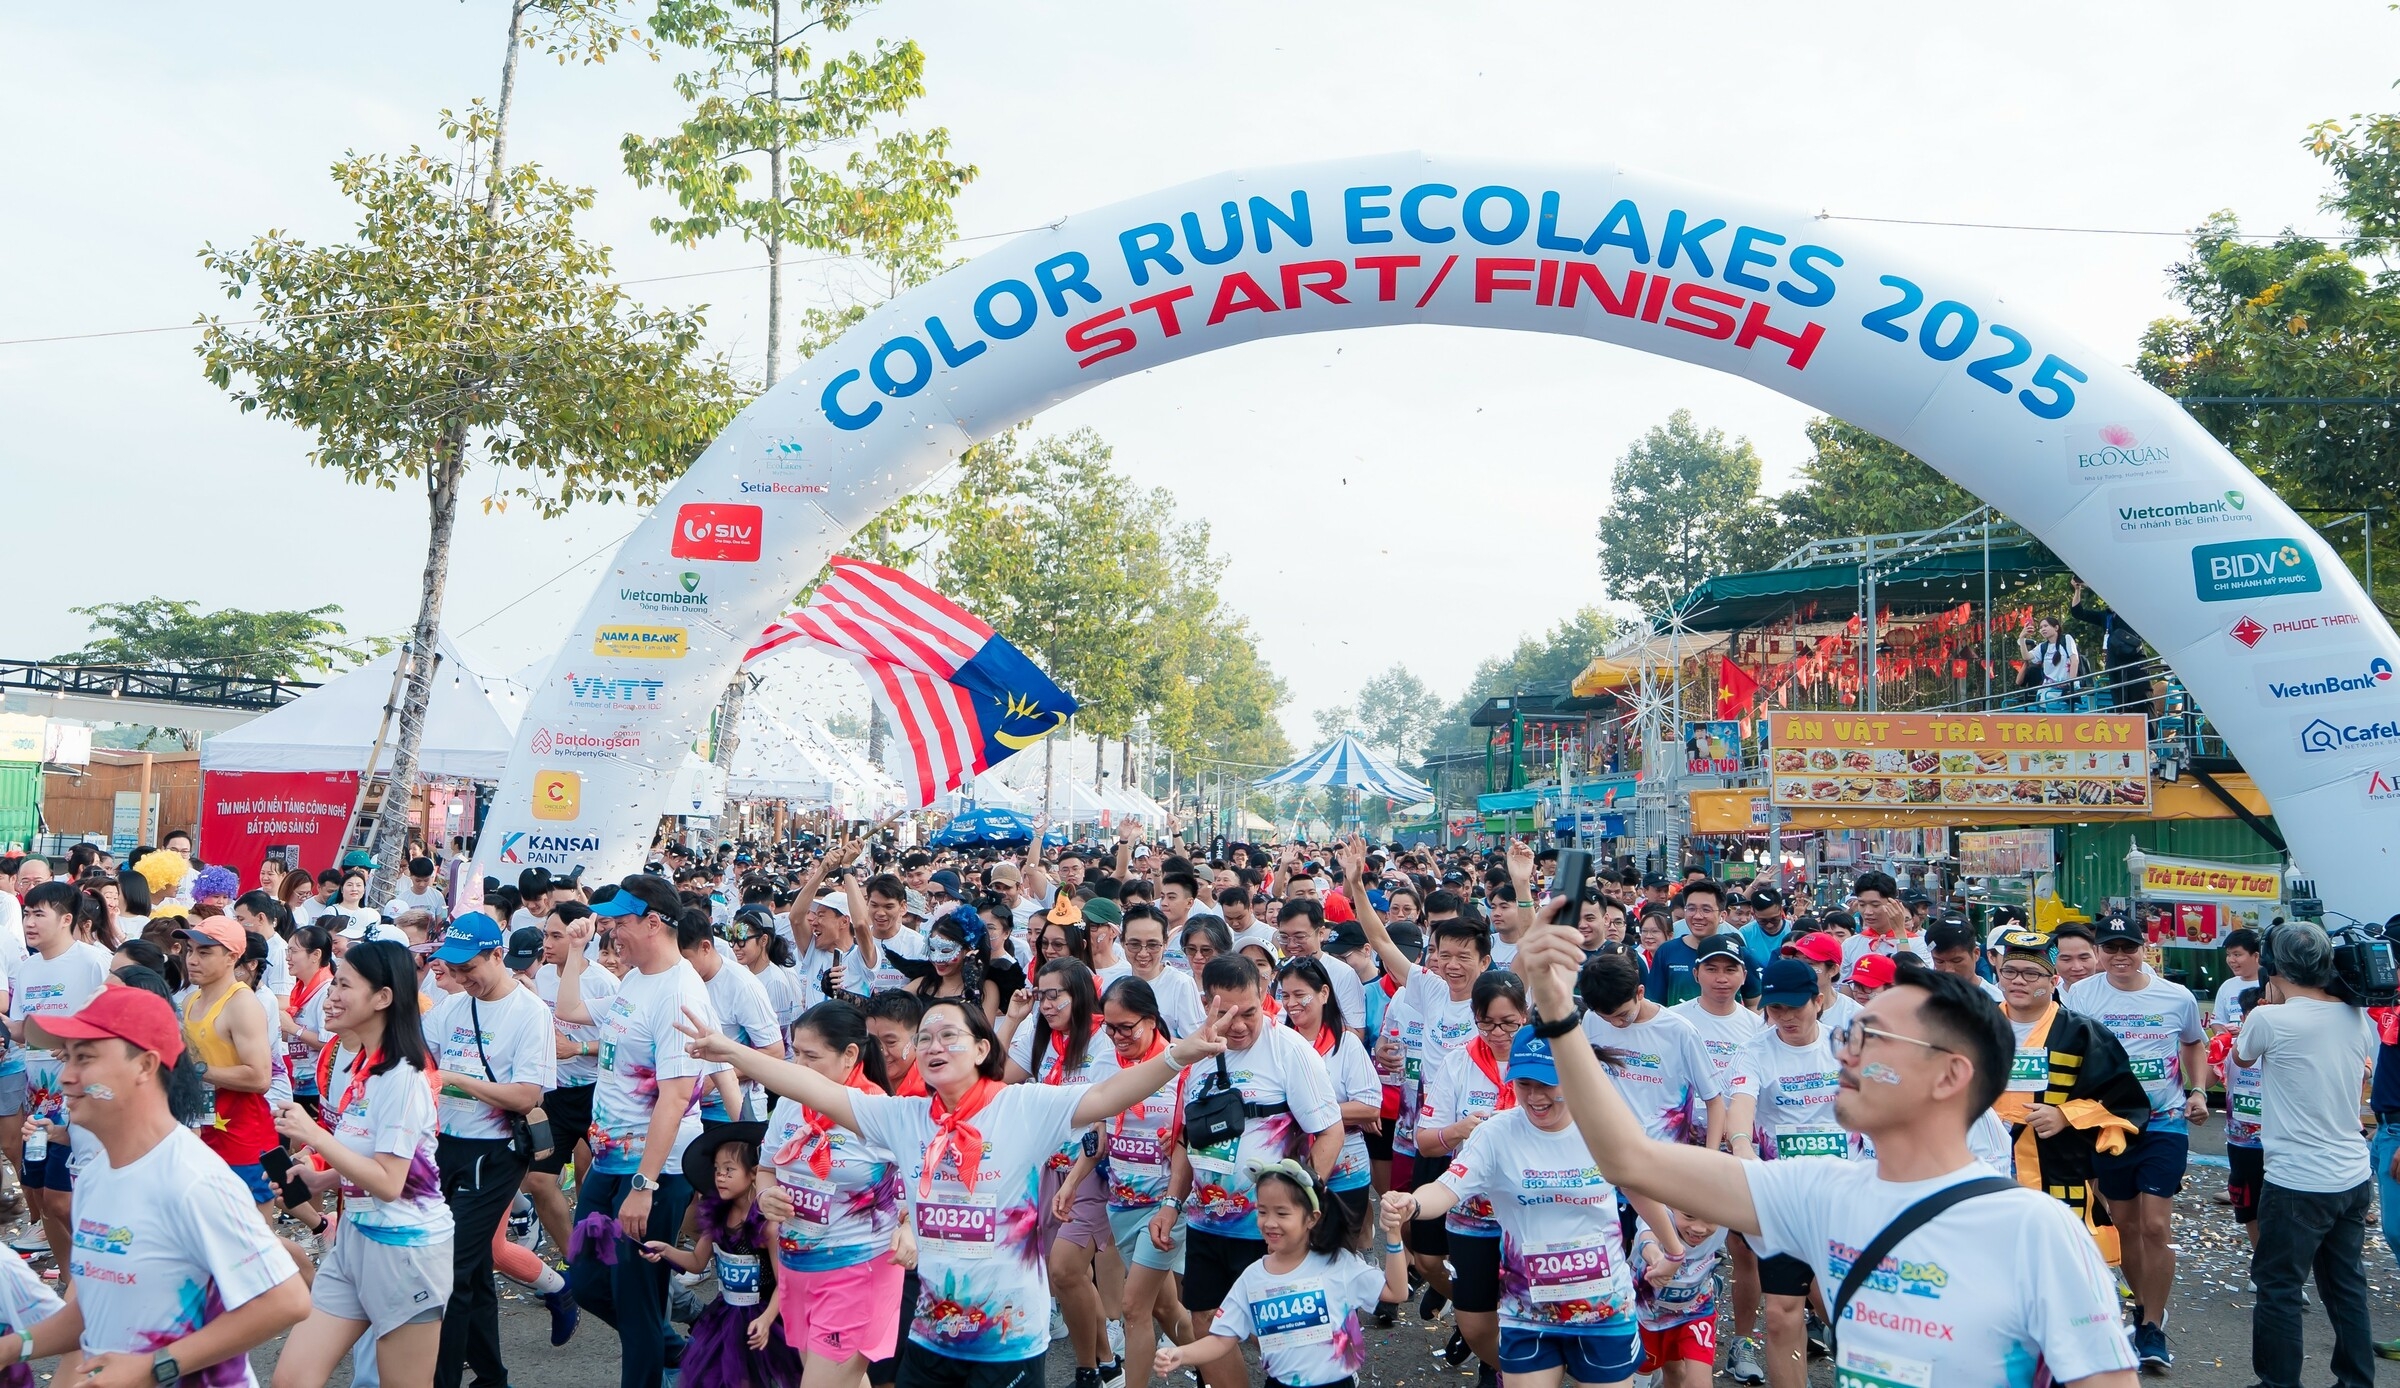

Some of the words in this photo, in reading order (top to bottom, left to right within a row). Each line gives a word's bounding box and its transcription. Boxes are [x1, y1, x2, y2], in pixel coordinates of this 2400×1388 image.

[821, 251, 1102, 430] COLOR
[1118, 189, 1313, 286] RUN
[1344, 183, 1844, 308] ECOLAKES
[1861, 274, 2088, 419] 2025
[1474, 257, 1826, 371] FINISH
[2119, 499, 2227, 521] Vietcombank
[715, 524, 752, 539] SIV
[2120, 522, 2136, 531] Chi
[2140, 519, 2171, 530] nhánh
[2210, 551, 2277, 581] BIDV
[2214, 583, 2229, 591] CHI
[2231, 579, 2262, 589] NHÁNH
[2264, 576, 2276, 586] MỸ
[621, 588, 708, 605] Vietcombank
[602, 632, 629, 641] NAM
[642, 633, 678, 643] BANK
[572, 677, 664, 701] VNTT
[2268, 673, 2377, 699] VietinBank
[574, 701, 602, 709] member
[1929, 717, 1986, 744] TRÀ
[1996, 716, 2063, 743] TRÁI
[2074, 718, 2131, 745] CÂY
[556, 733, 640, 750] Batdongsan
[564, 749, 617, 758] PropertyGuru
[1688, 759, 1709, 773] KEM
[217, 798, 232, 815] TÌM
[233, 797, 250, 814] NHÀ
[252, 797, 267, 813] VỚI
[267, 795, 283, 813] NỀN
[284, 797, 305, 813] TẢNG
[306, 799, 327, 815] CÔNG
[328, 803, 347, 820] NGHỆ
[247, 816, 263, 834] BẤT
[264, 818, 287, 836] ĐỘNG
[288, 819, 304, 834] SẢN
[305, 817, 315, 834] SỐ
[528, 835, 599, 851] KANSAI
[527, 852, 568, 864] PAINT
[2147, 867, 2171, 884] Trà
[2175, 869, 2205, 887] Trái
[2208, 872, 2238, 892] Cây
[1112, 1137, 1155, 1155] 20325
[1786, 1136, 1840, 1152] 10381
[1522, 1168, 1558, 1178] COLOR
[1558, 1168, 1580, 1178] RUN
[780, 1185, 822, 1211] 0319
[924, 1207, 985, 1229] 20320
[1535, 1251, 1598, 1274] 20439
[1900, 1260, 1948, 1288] 2025
[1260, 1295, 1316, 1321] 40148
[1689, 1321, 1714, 1348] 12
